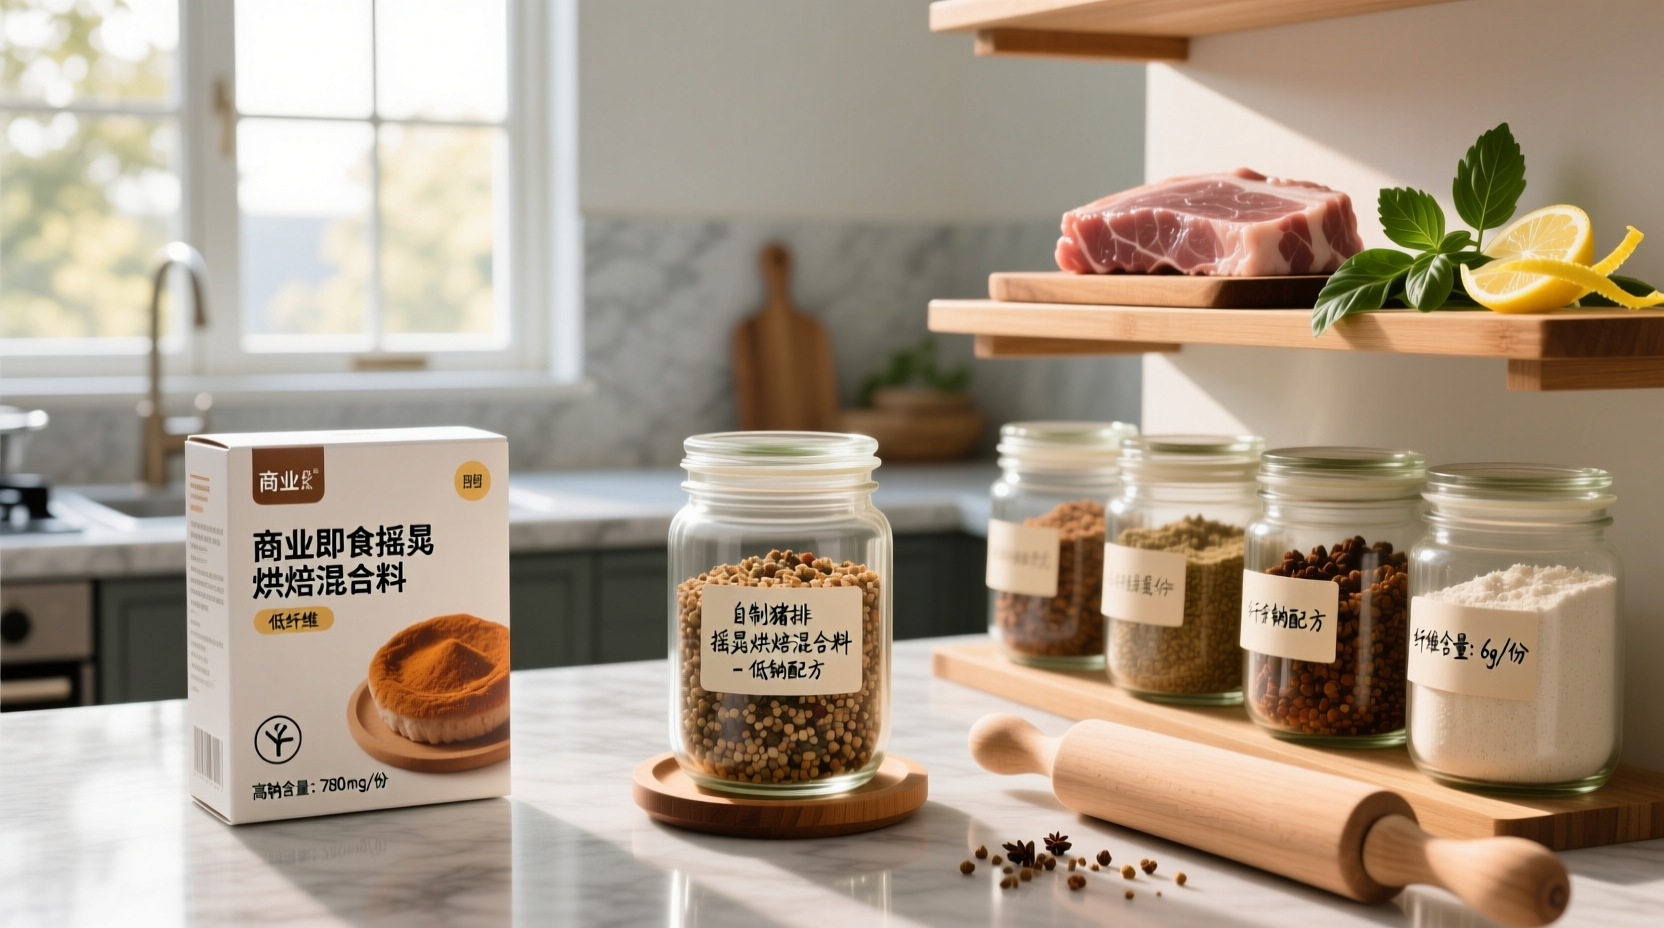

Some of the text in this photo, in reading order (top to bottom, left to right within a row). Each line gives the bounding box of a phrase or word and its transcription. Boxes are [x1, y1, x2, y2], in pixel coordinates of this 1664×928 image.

[253, 524, 434, 563] 商业即食摇晃
[253, 561, 407, 600] 烘焙混合料
[734, 602, 813, 627] 自制猪排
[710, 629, 853, 656] 摇晃烘焙混合料
[1481, 637, 1530, 670] 6g/份
[320, 772, 389, 793] 780mg/份
